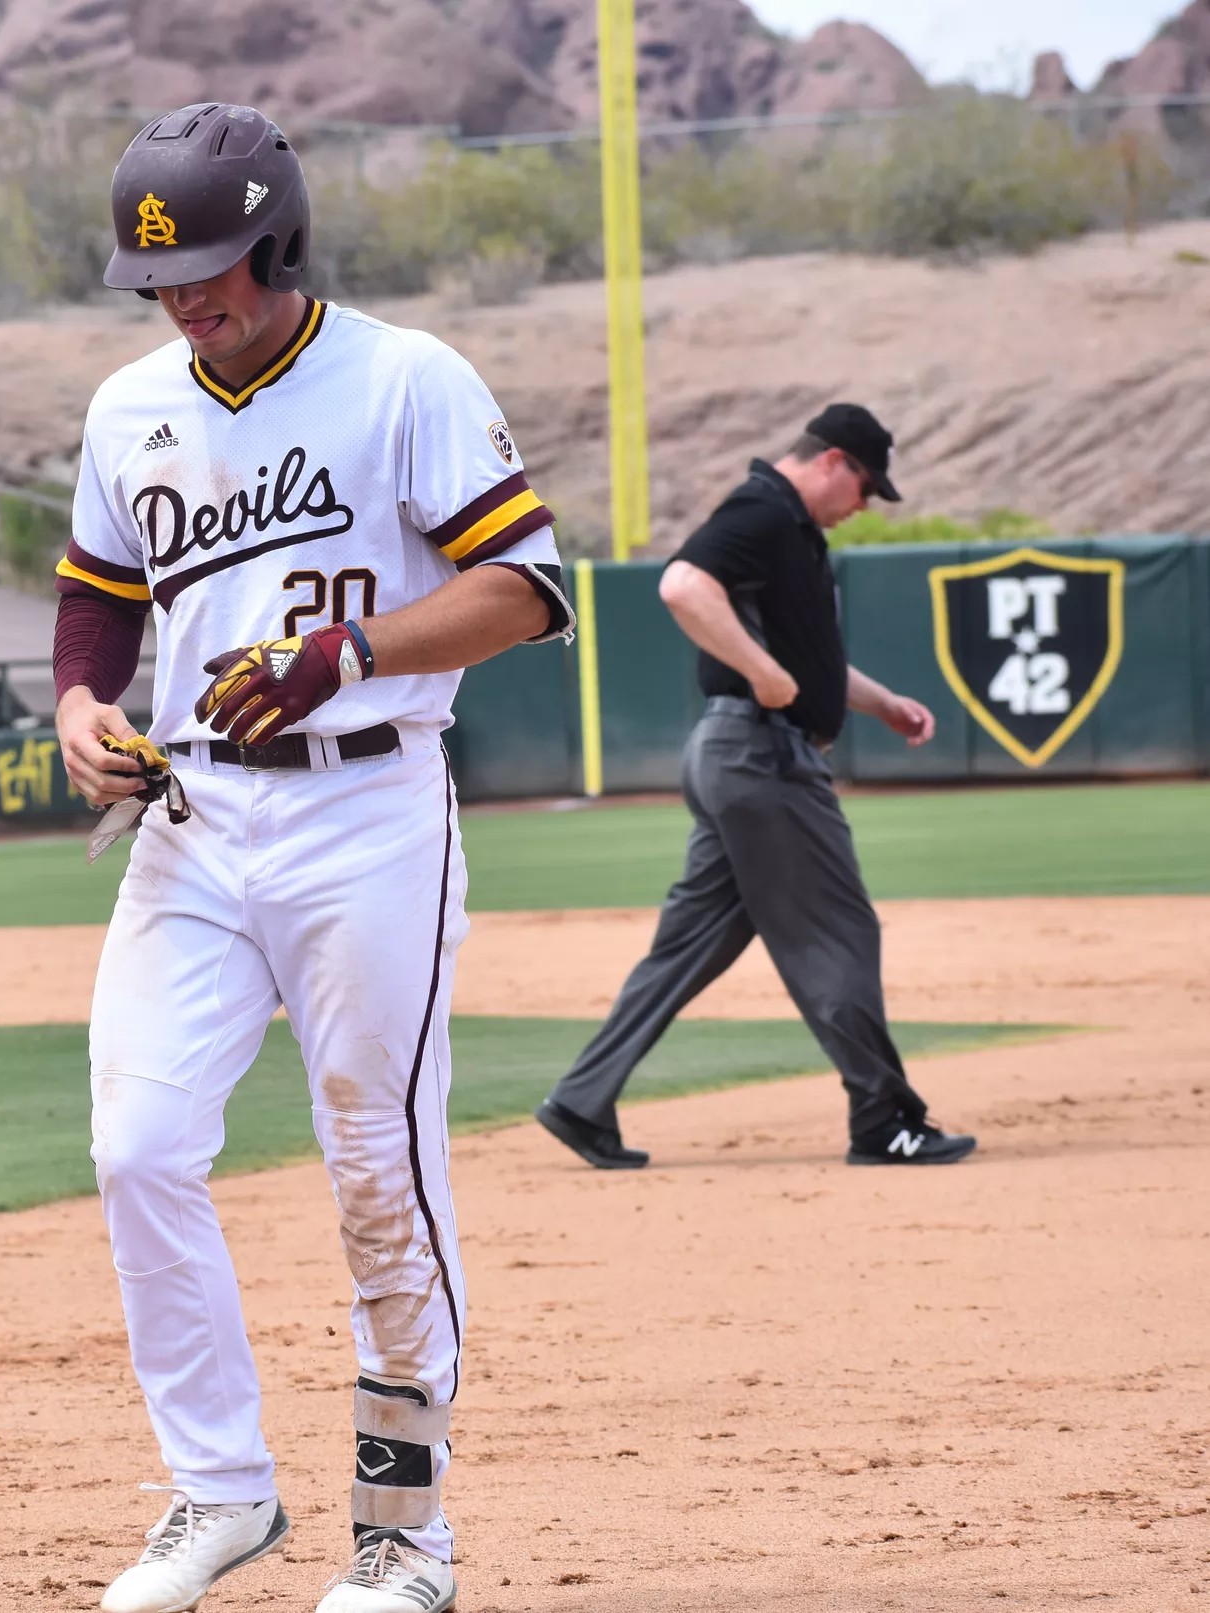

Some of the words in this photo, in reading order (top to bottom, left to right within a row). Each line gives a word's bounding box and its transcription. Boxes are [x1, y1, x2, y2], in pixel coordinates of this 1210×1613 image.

[244, 184, 269, 215] adidas
[144, 437, 179, 452] adidas
[132, 446, 354, 575] Devils
[282, 568, 377, 640] 20
[987, 576, 1066, 639] PT
[275, 651, 296, 679] adidas
[988, 653, 1071, 715] 42
